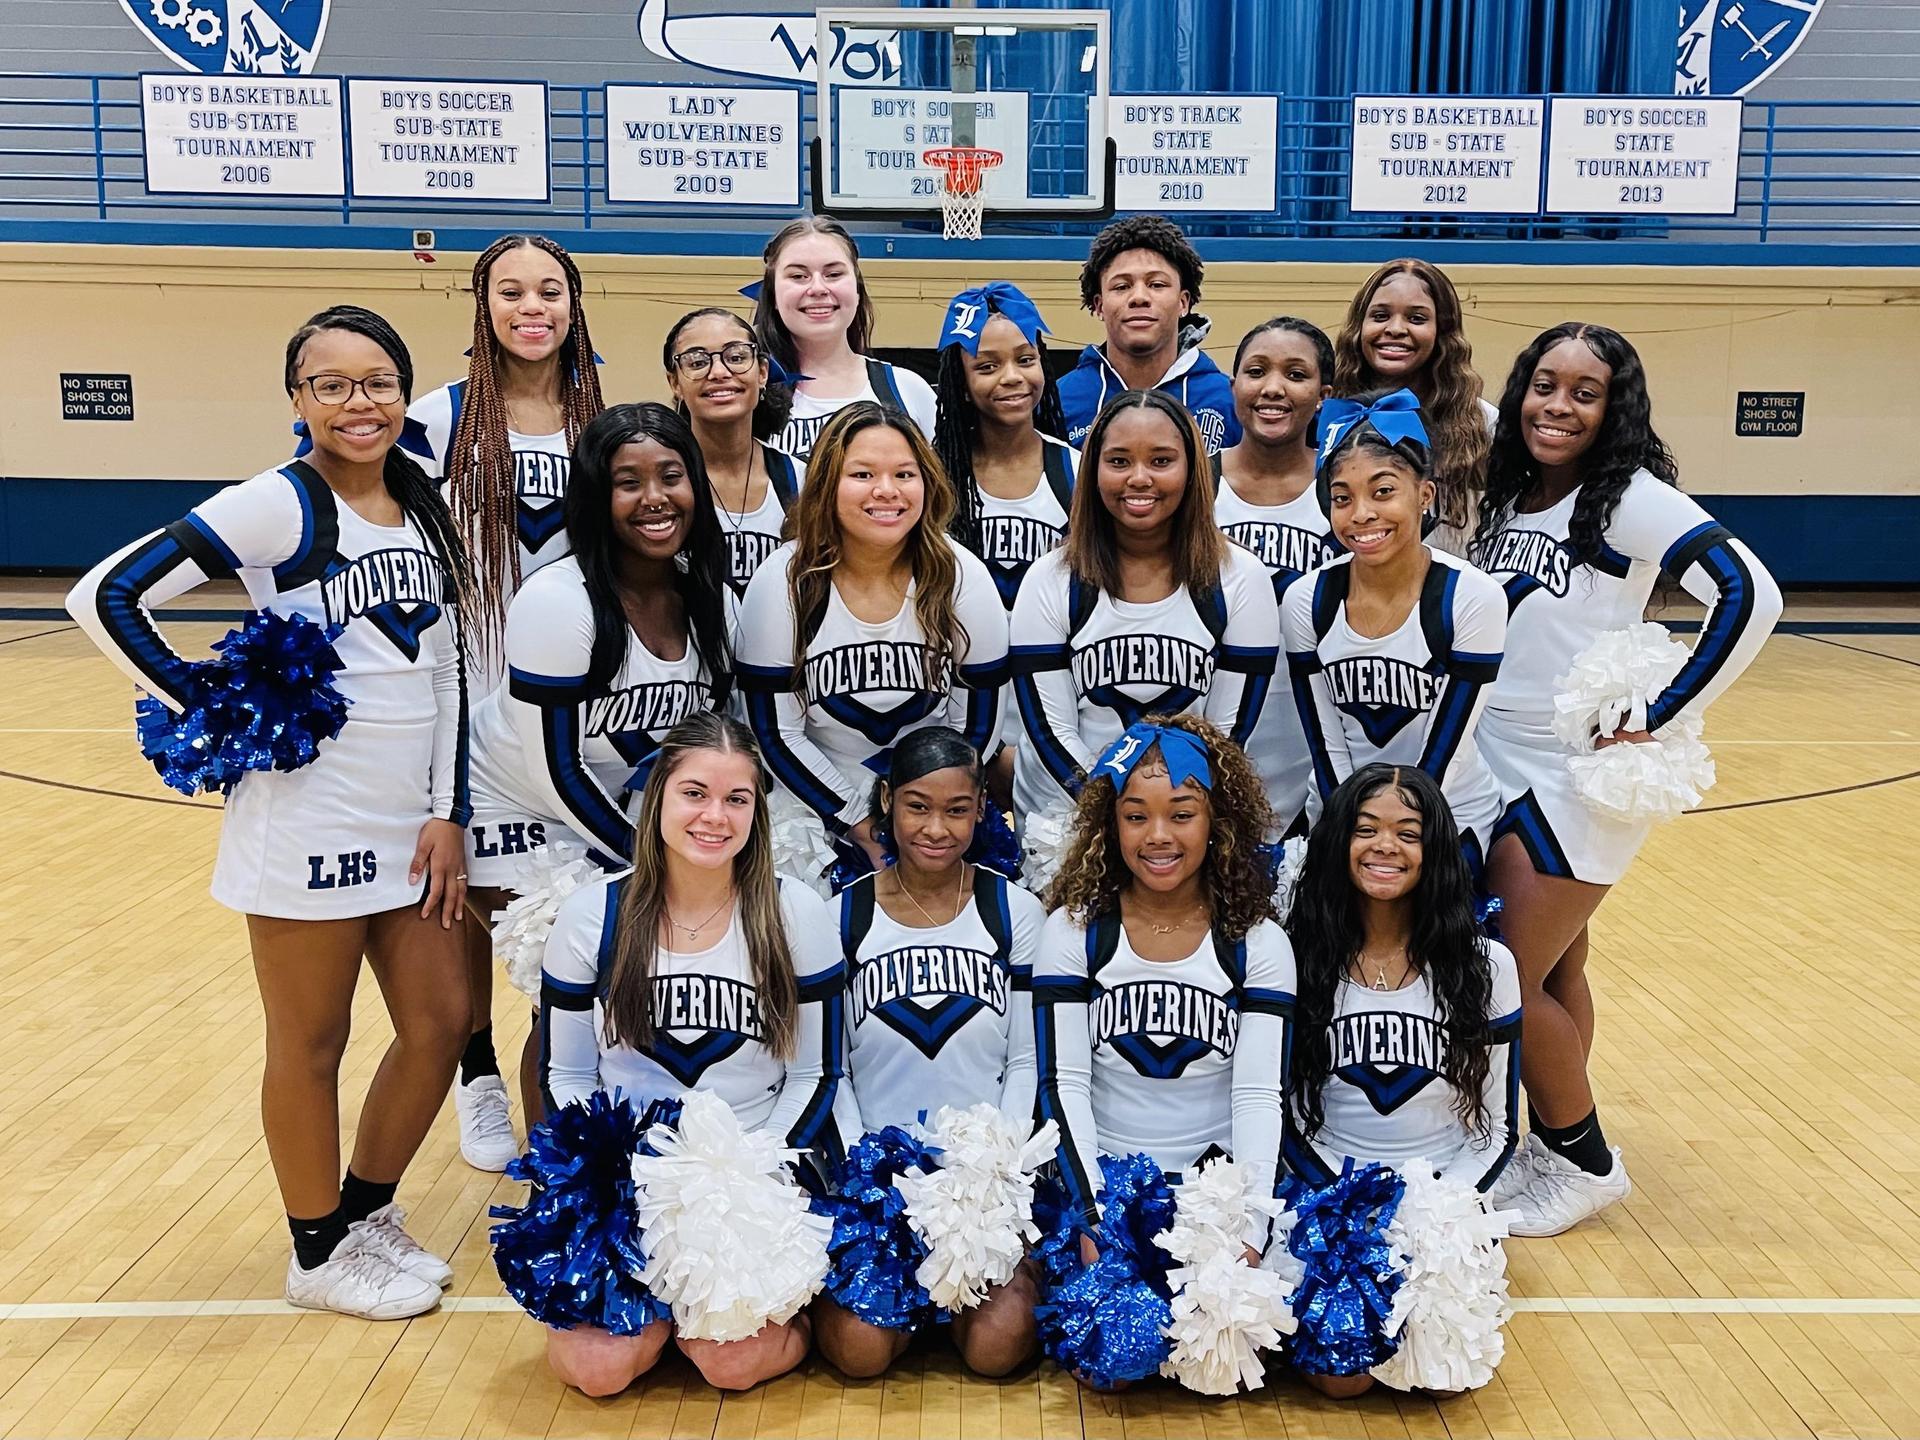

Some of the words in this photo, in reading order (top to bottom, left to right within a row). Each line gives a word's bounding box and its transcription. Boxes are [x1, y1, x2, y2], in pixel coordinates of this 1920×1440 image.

[151, 85, 203, 104] BOYS
[209, 86, 333, 106] BASKETBALL
[381, 91, 432, 110] BOYS
[438, 91, 513, 111] SOCCER
[669, 96, 736, 116] LADY
[1125, 105, 1174, 123] BOYS
[1179, 105, 1241, 123] TRACK
[189, 110, 299, 131] SUB-STATE
[1358, 108, 1407, 125] BOYS
[1412, 108, 1539, 126] BASKETBALL
[1584, 109, 1634, 126] BOYS
[1638, 109, 1708, 127] SOCCER
[394, 118, 503, 138] SUB-STATE
[623, 121, 783, 143] WOLVERINES
[174, 137, 316, 158] TOURNAMENT
[1153, 131, 1212, 150] STATE
[1390, 133, 1428, 151] SUB
[1446, 133, 1506, 151] STATE
[1615, 134, 1674, 152] STATE
[379, 143, 519, 164] TOURNAMENT
[639, 148, 769, 169] SUB-STATE
[222, 165, 272, 184] 2006
[1116, 157, 1249, 176] TOURNAMENT
[1378, 159, 1515, 178] TOURNAMENT
[1575, 159, 1711, 178] TOURNAMENT
[425, 170, 475, 189] 2008
[674, 175, 734, 194] 2009
[1159, 183, 1204, 201] 2010
[1423, 185, 1468, 203] 2012
[1619, 185, 1664, 203] 2013
[950, 302, 981, 339] L
[63, 379, 80, 389] NO
[86, 379, 128, 389] STREET
[67, 392, 105, 402] SHOES
[111, 392, 128, 402] ON
[1742, 398, 1757, 407] NO
[1762, 397, 1798, 407] STREET
[64, 405, 89, 414] GYM
[95, 405, 131, 415] FLOOR
[1744, 410, 1777, 419] SHOES
[1781, 410, 1796, 420] ON
[1740, 422, 1761, 432] GYM
[1766, 422, 1798, 432] FLOOR
[1071, 634, 1215, 697] WOLVERINES
[1104, 735, 1142, 774] L
[472, 822, 547, 858] LHS
[308, 850, 377, 890] LHS
[852, 945, 1007, 1030] WOLVERINES
[1088, 980, 1239, 1057] WOLVERINES
